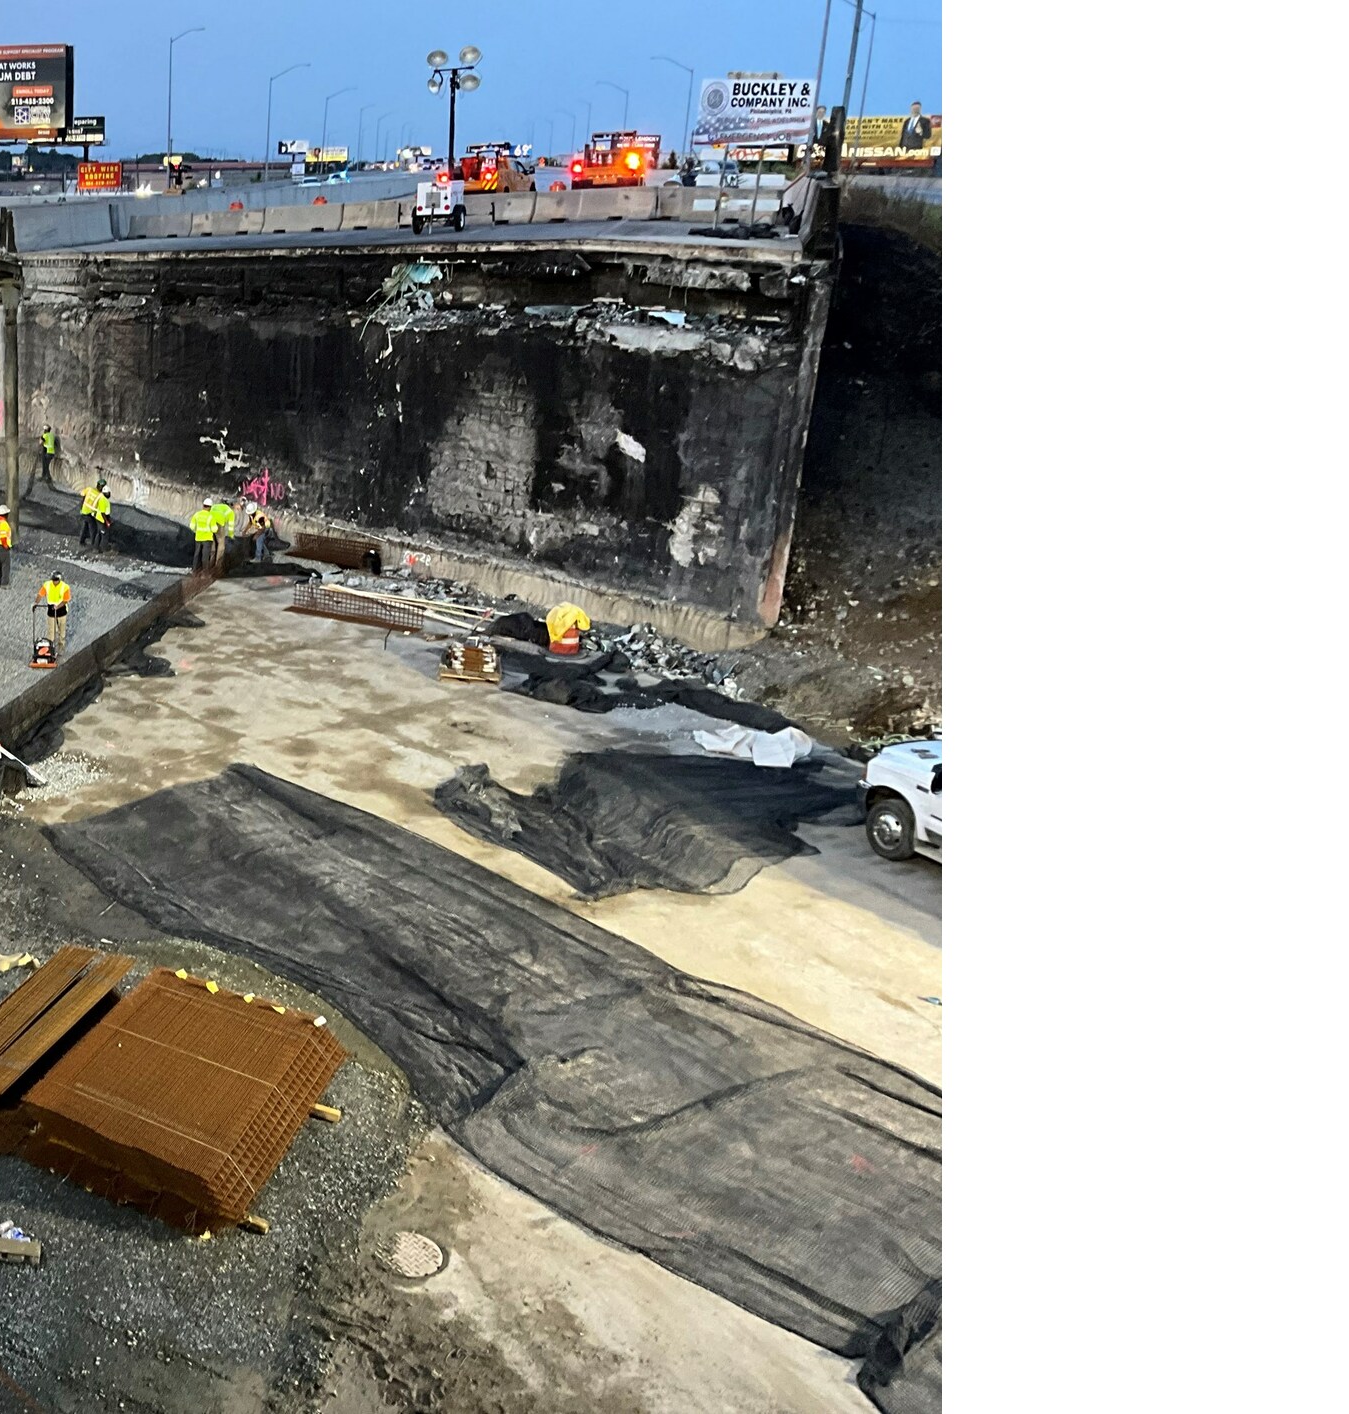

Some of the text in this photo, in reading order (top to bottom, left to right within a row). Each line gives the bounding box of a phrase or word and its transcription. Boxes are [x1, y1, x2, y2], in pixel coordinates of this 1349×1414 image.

[8, 61, 36, 70] WORKS
[14, 71, 36, 81] DEBT
[732, 82, 810, 96] BUCKLEY &
[730, 97, 811, 108] COMPANY INC.
[84, 172, 115, 180] ROOFING
